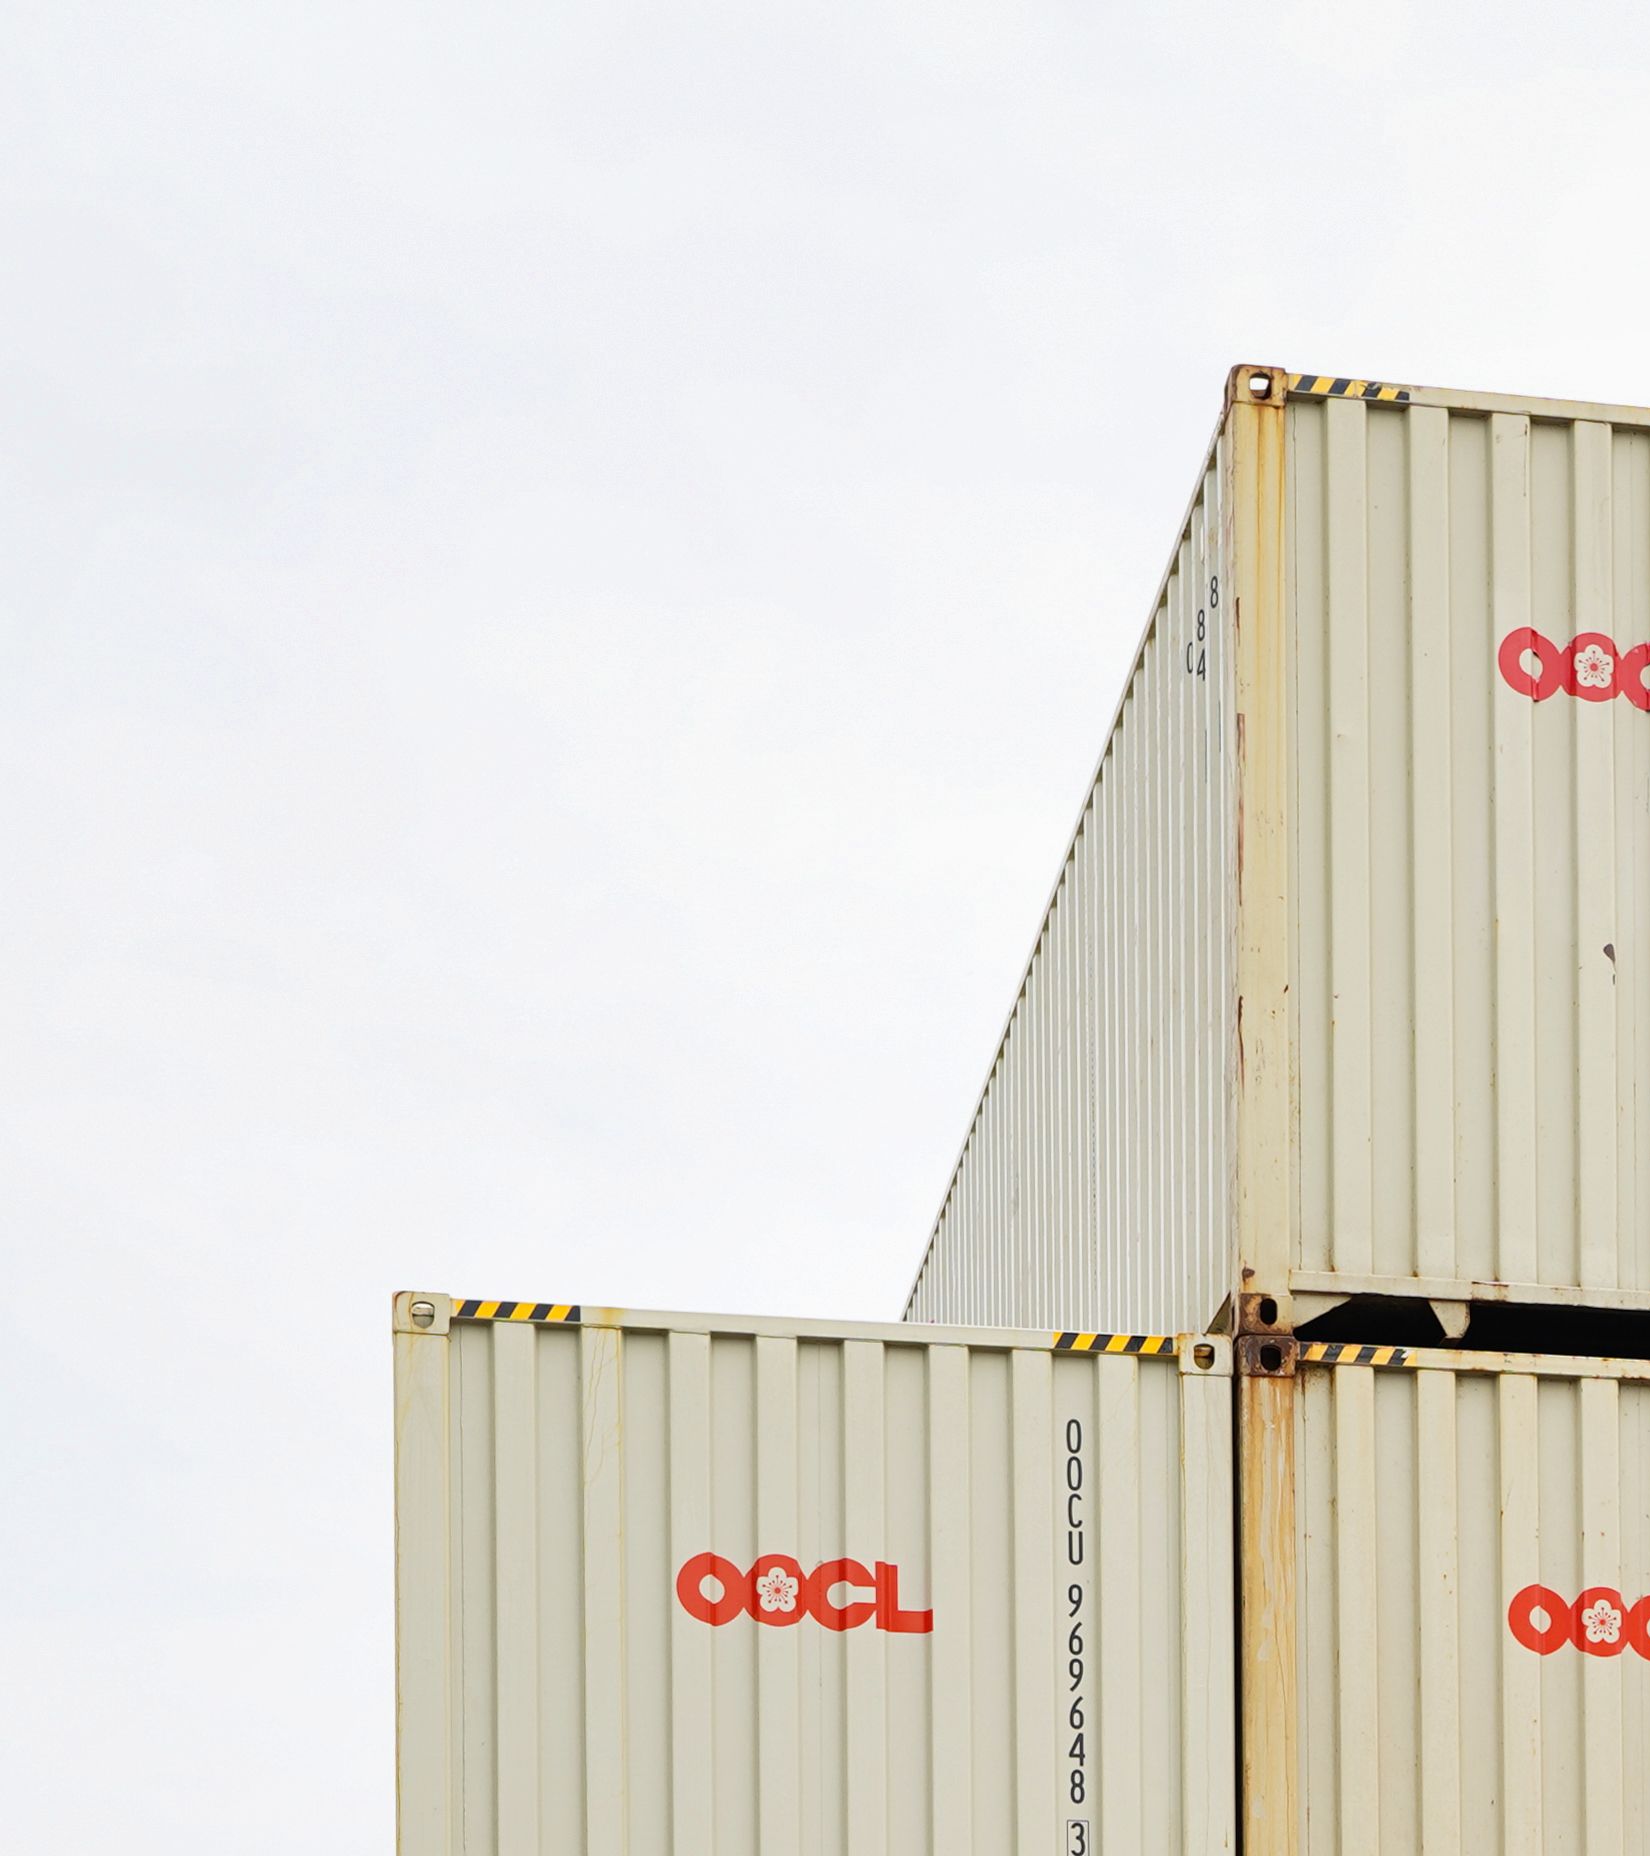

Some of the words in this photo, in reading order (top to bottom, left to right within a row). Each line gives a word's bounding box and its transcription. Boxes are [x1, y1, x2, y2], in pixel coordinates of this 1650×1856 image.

[1065, 1418, 1083, 1566] OOCU
[676, 1552, 934, 1634] OOCL
[1067, 1584, 1086, 1805] 969648
